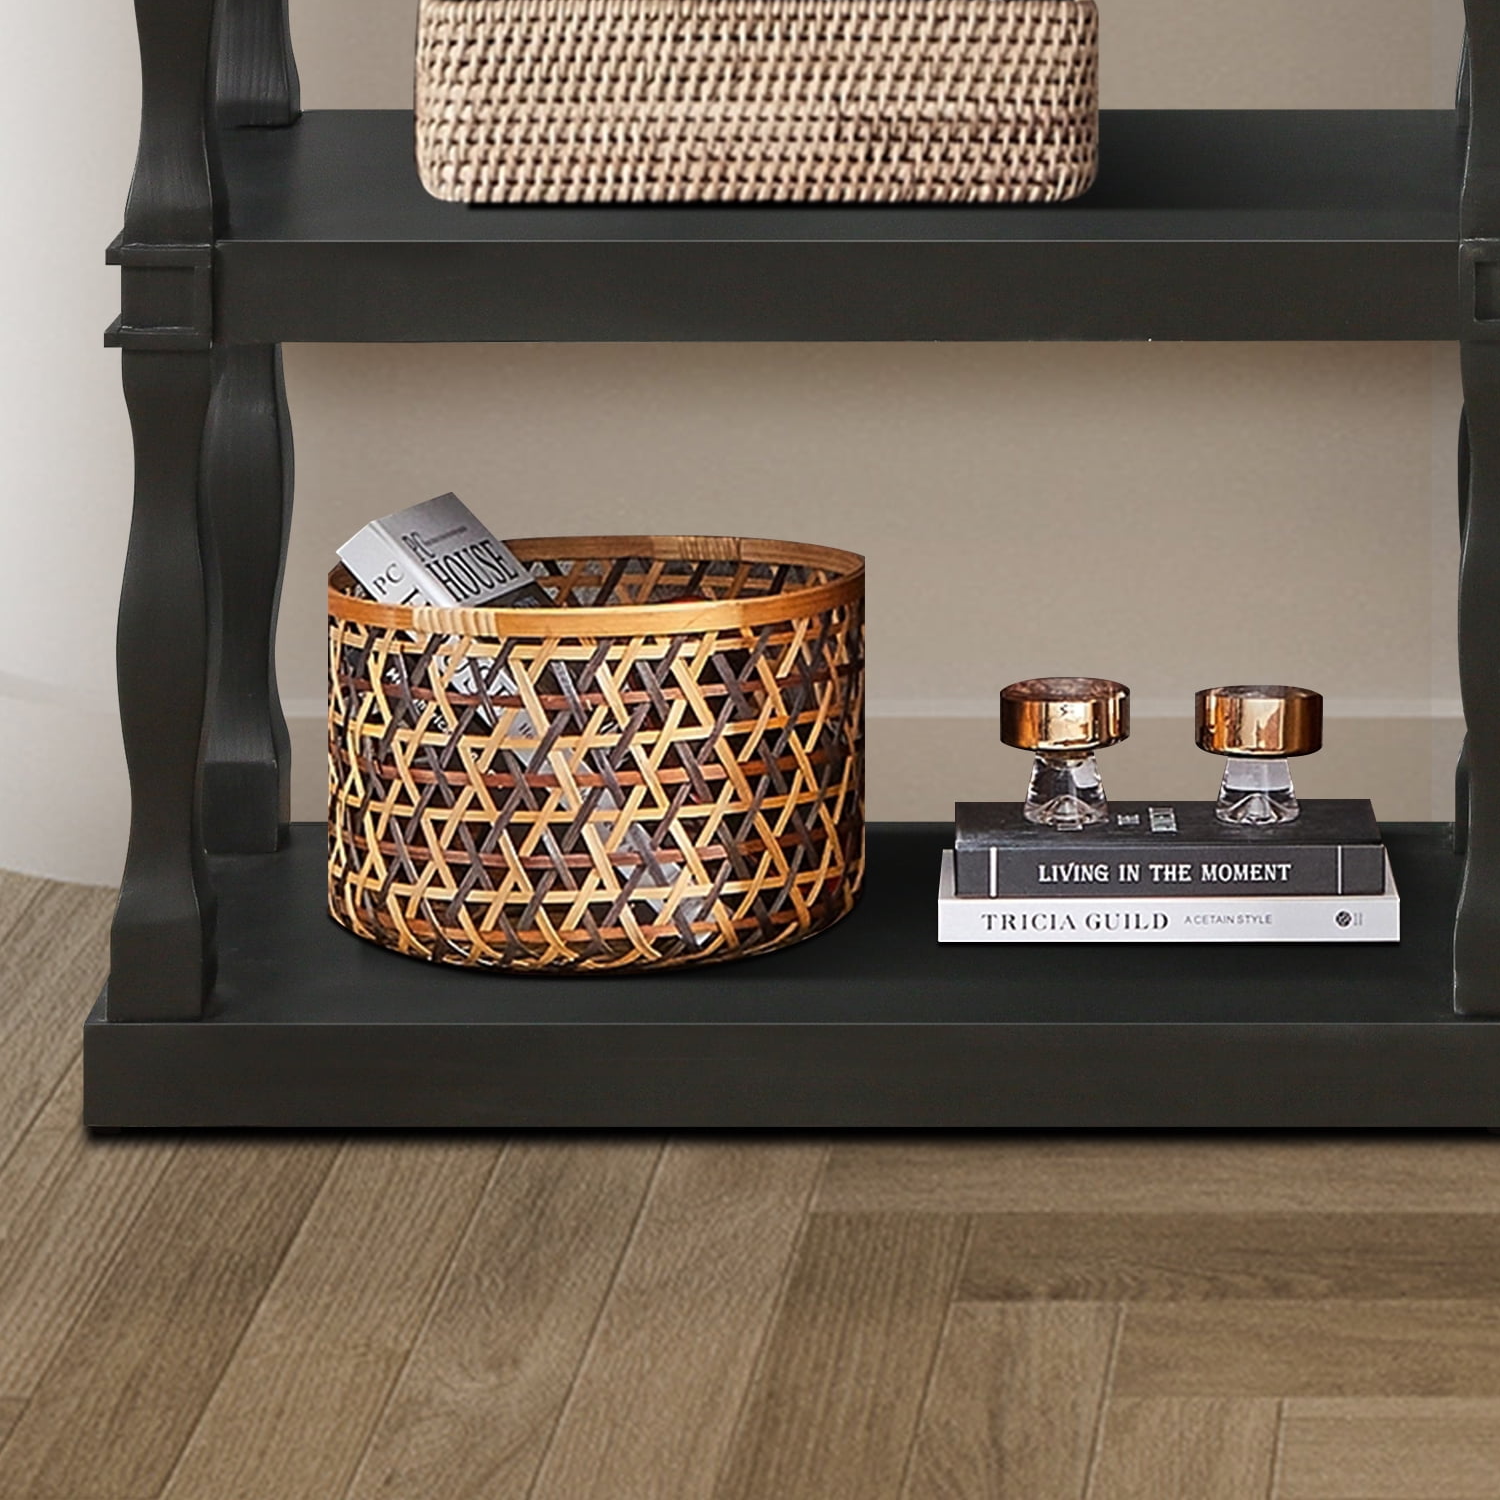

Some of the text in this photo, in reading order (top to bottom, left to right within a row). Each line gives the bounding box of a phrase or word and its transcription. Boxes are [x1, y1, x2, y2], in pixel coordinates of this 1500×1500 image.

[402, 531, 436, 562] PC
[373, 563, 405, 595] PC
[425, 539, 519, 602] HOUSE
[1038, 862, 1292, 883] LIVING IN THE MOMENT
[981, 913, 1076, 931] TRICIA
[1085, 912, 1169, 931] GUILD
